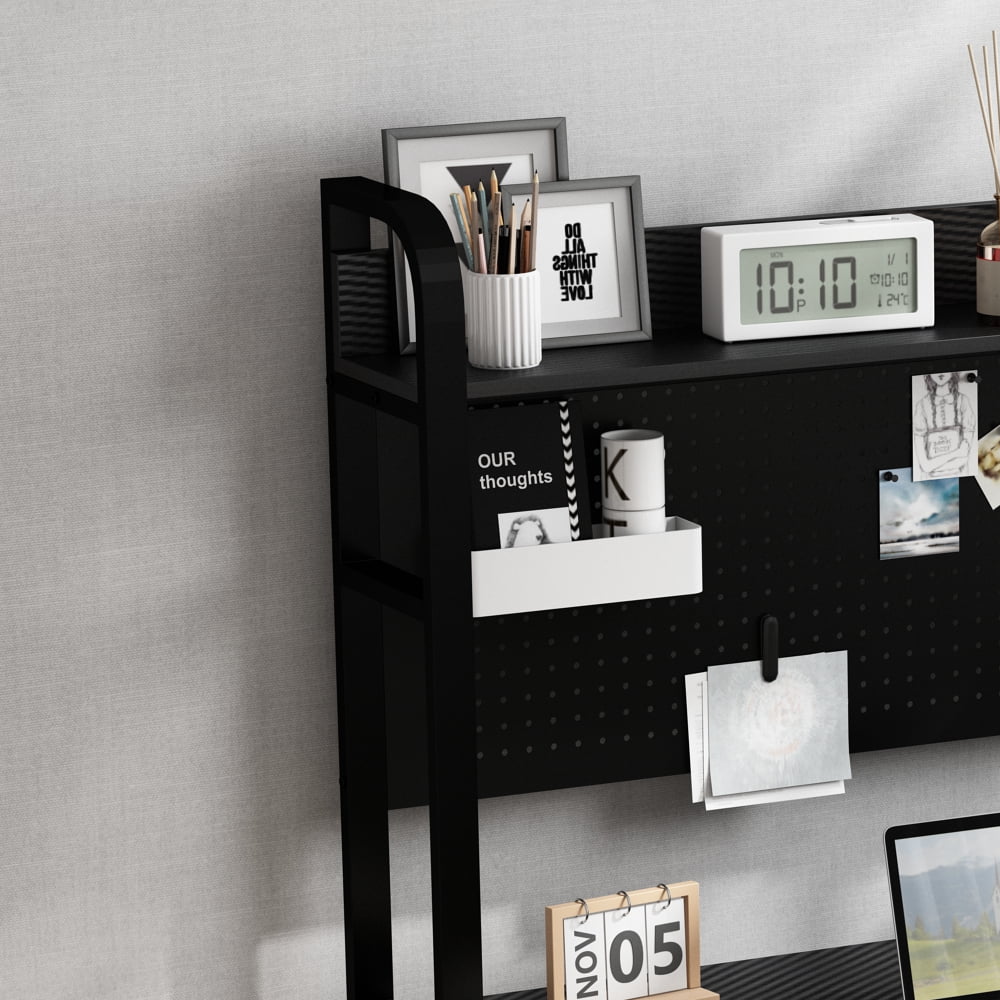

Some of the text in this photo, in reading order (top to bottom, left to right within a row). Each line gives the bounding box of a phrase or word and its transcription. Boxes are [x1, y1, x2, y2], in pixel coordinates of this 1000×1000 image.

[756, 256, 857, 315] 10:10
[881, 271, 909, 287] 10:10
[477, 451, 517, 469] OUR
[603, 446, 631, 501] K
[479, 469, 553, 490] thoughts
[573, 920, 683, 1000] NOV 05
